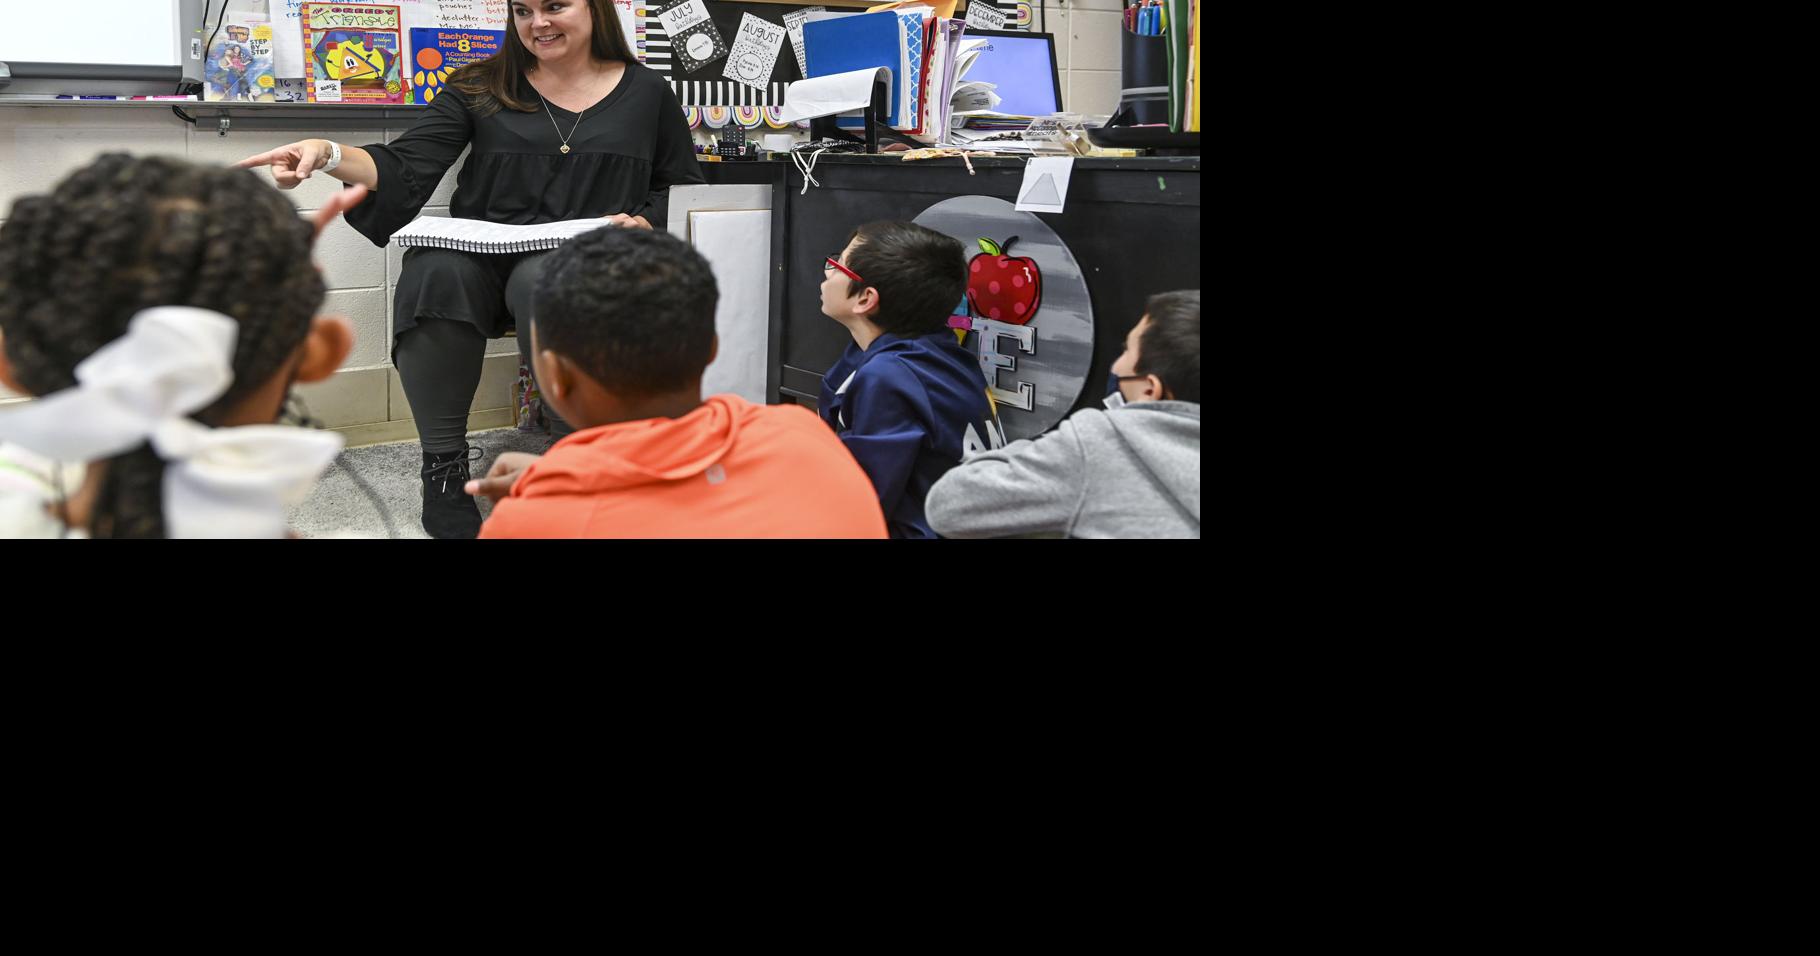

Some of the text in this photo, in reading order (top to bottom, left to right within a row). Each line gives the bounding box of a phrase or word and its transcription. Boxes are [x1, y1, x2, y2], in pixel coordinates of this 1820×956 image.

[311, 10, 396, 27] Triangle
[670, 3, 693, 22] JULY
[969, 6, 1004, 26] DECEMBER
[249, 38, 268, 46] STEP
[438, 32, 494, 41] Each Orange
[742, 22, 780, 45] AUGUST
[438, 40, 457, 48] Had
[457, 39, 471, 52] 8
[286, 90, 304, 101] 32
[971, 318, 1036, 411] E
